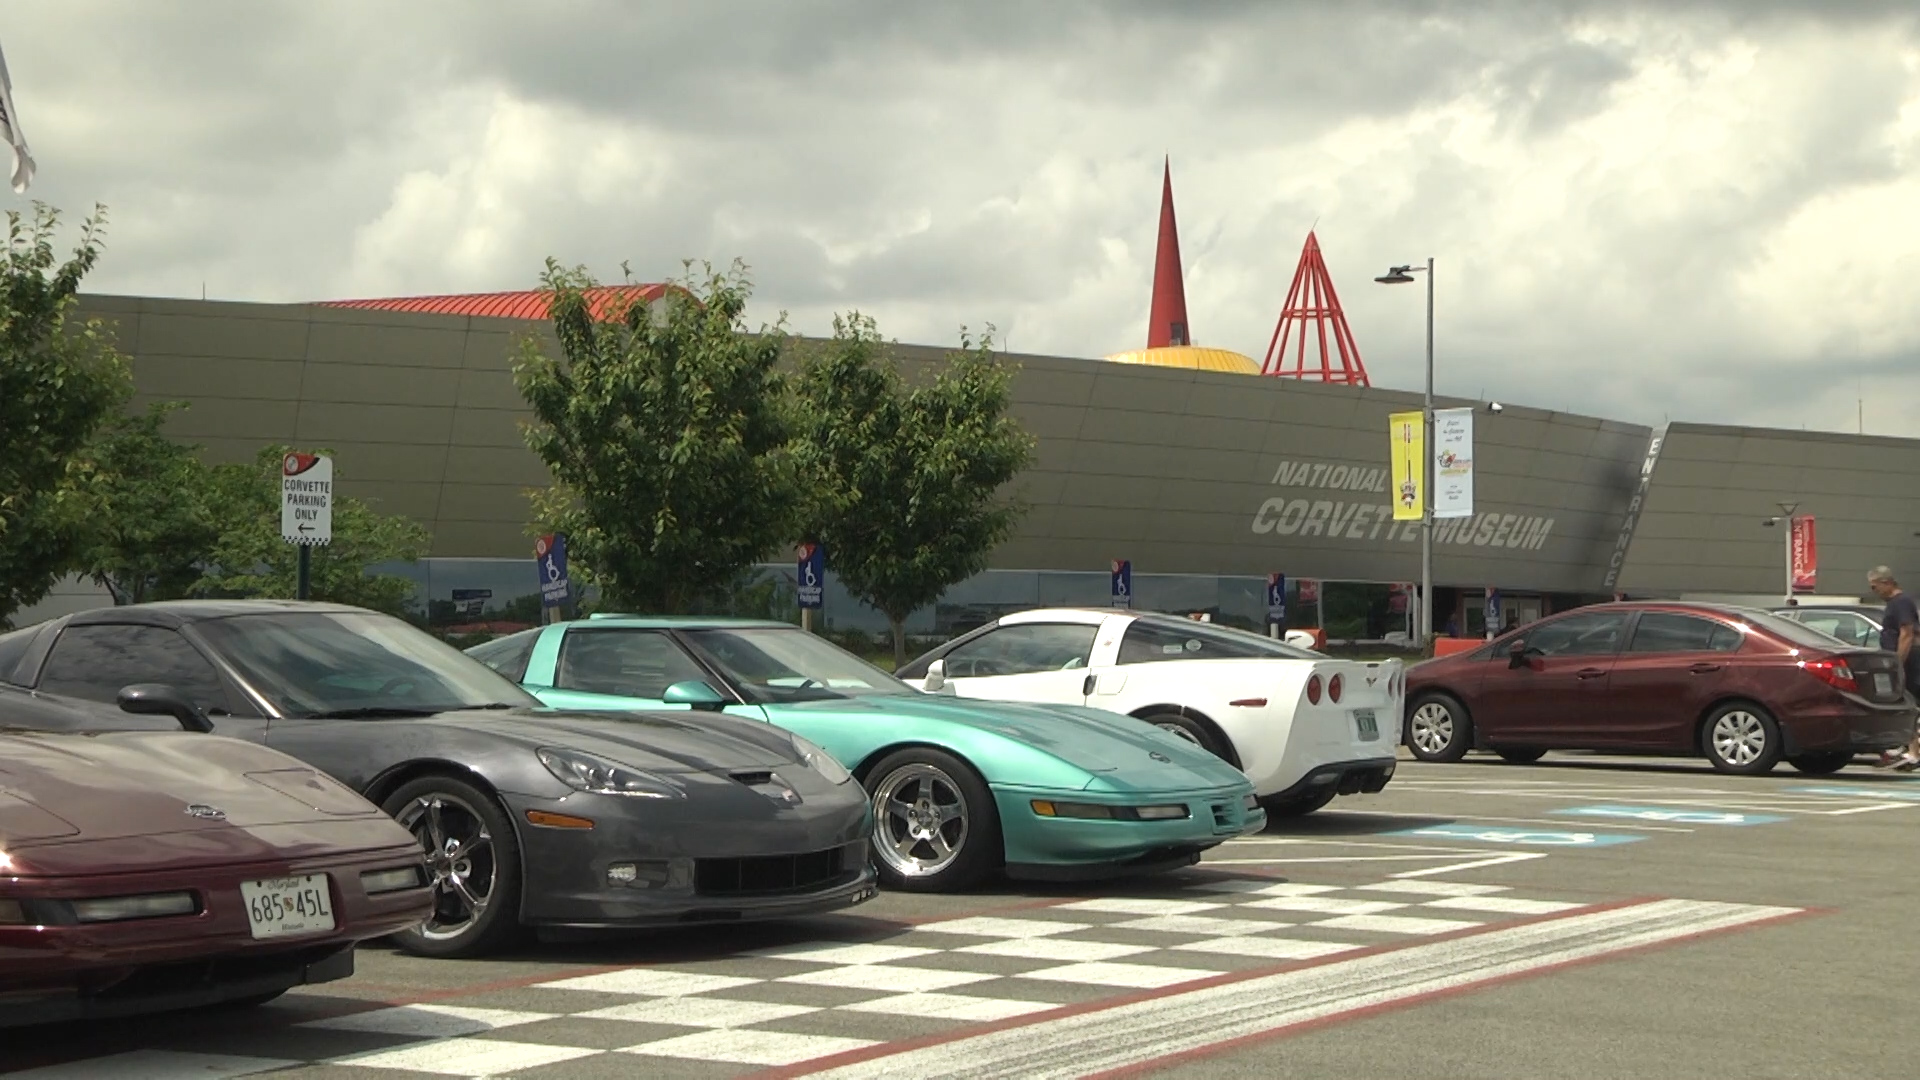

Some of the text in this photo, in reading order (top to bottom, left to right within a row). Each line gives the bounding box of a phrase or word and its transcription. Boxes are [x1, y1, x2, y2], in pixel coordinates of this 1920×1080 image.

[284, 479, 330, 493] CORVETTE
[1271, 461, 1388, 493] NATIONAL
[287, 493, 327, 507] PARKING
[295, 507, 318, 520] ONLY
[1428, 511, 1555, 550] MUSEUM
[1793, 520, 1804, 577] NTRANCE
[251, 889, 329, 923] 685 45L
